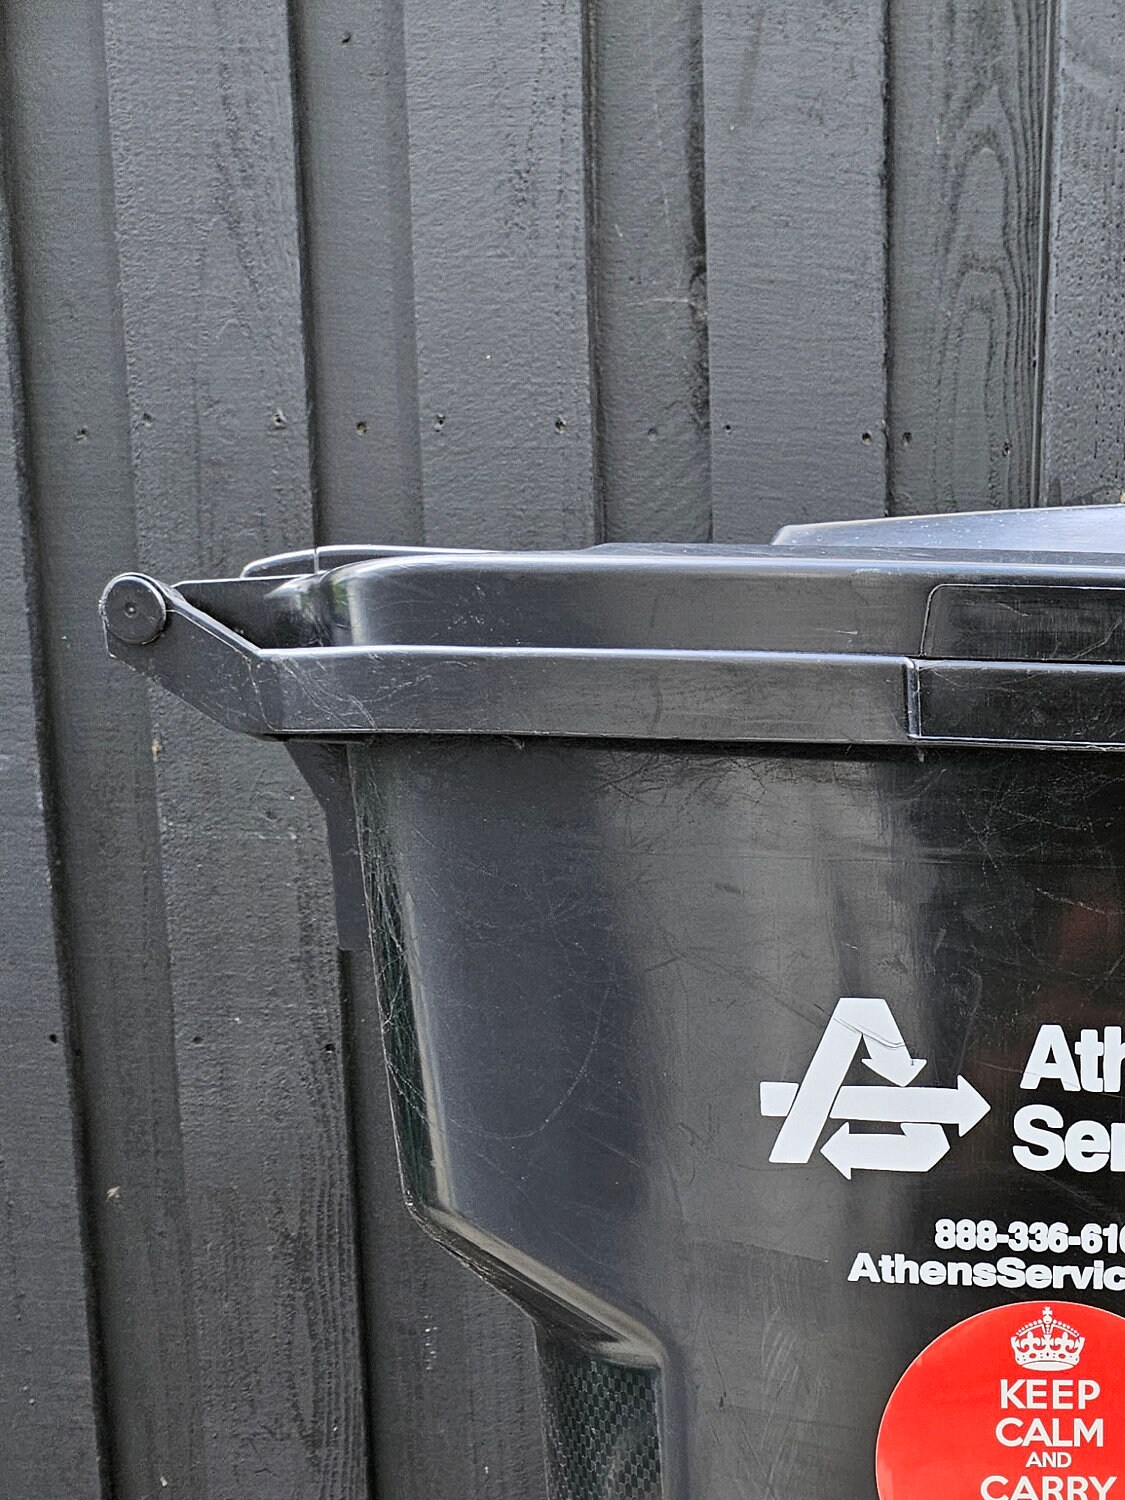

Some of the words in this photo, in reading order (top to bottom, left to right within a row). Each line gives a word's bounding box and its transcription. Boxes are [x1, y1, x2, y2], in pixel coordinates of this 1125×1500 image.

[1001, 1379, 1100, 1409] KEEP
[996, 1418, 1103, 1447] CALM
[1026, 1452, 1071, 1468] AND
